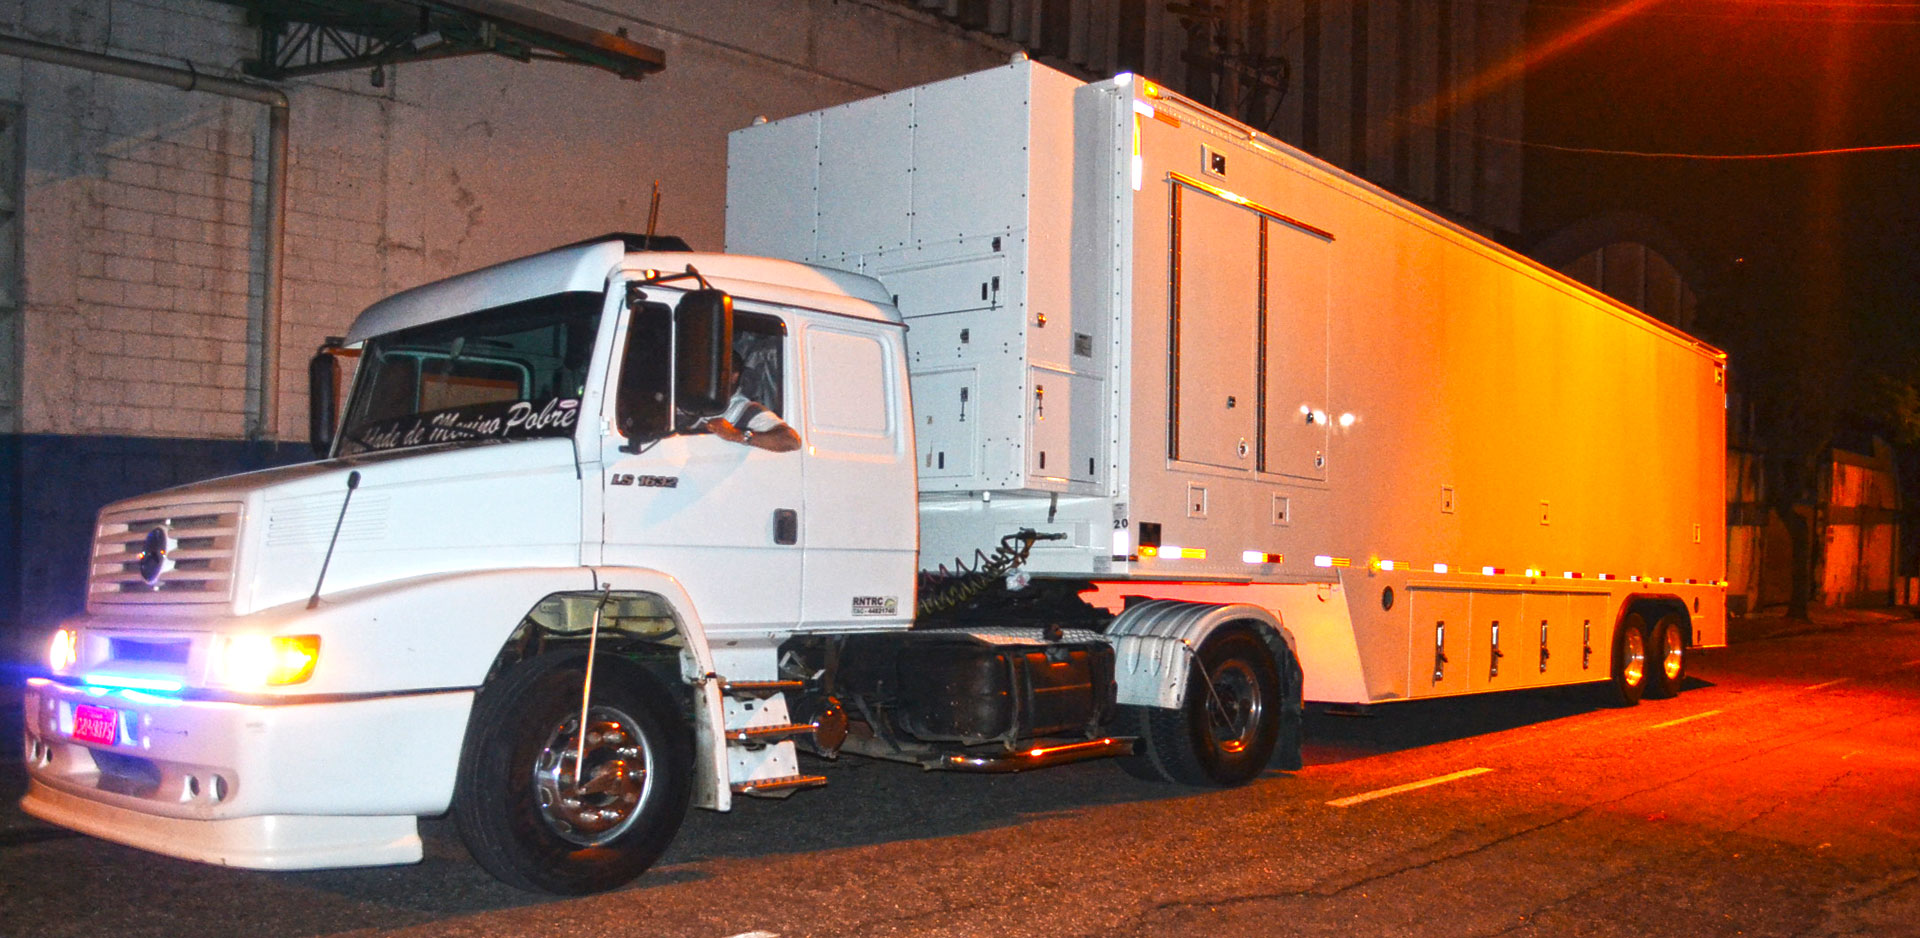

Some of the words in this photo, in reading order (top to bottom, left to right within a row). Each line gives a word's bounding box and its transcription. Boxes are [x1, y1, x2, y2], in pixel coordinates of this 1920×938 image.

[403, 418, 426, 445] de
[503, 397, 576, 435] Pobre
[611, 473, 635, 486] LS
[1113, 518, 1129, 529] 20
[853, 596, 884, 606] RNTRC
